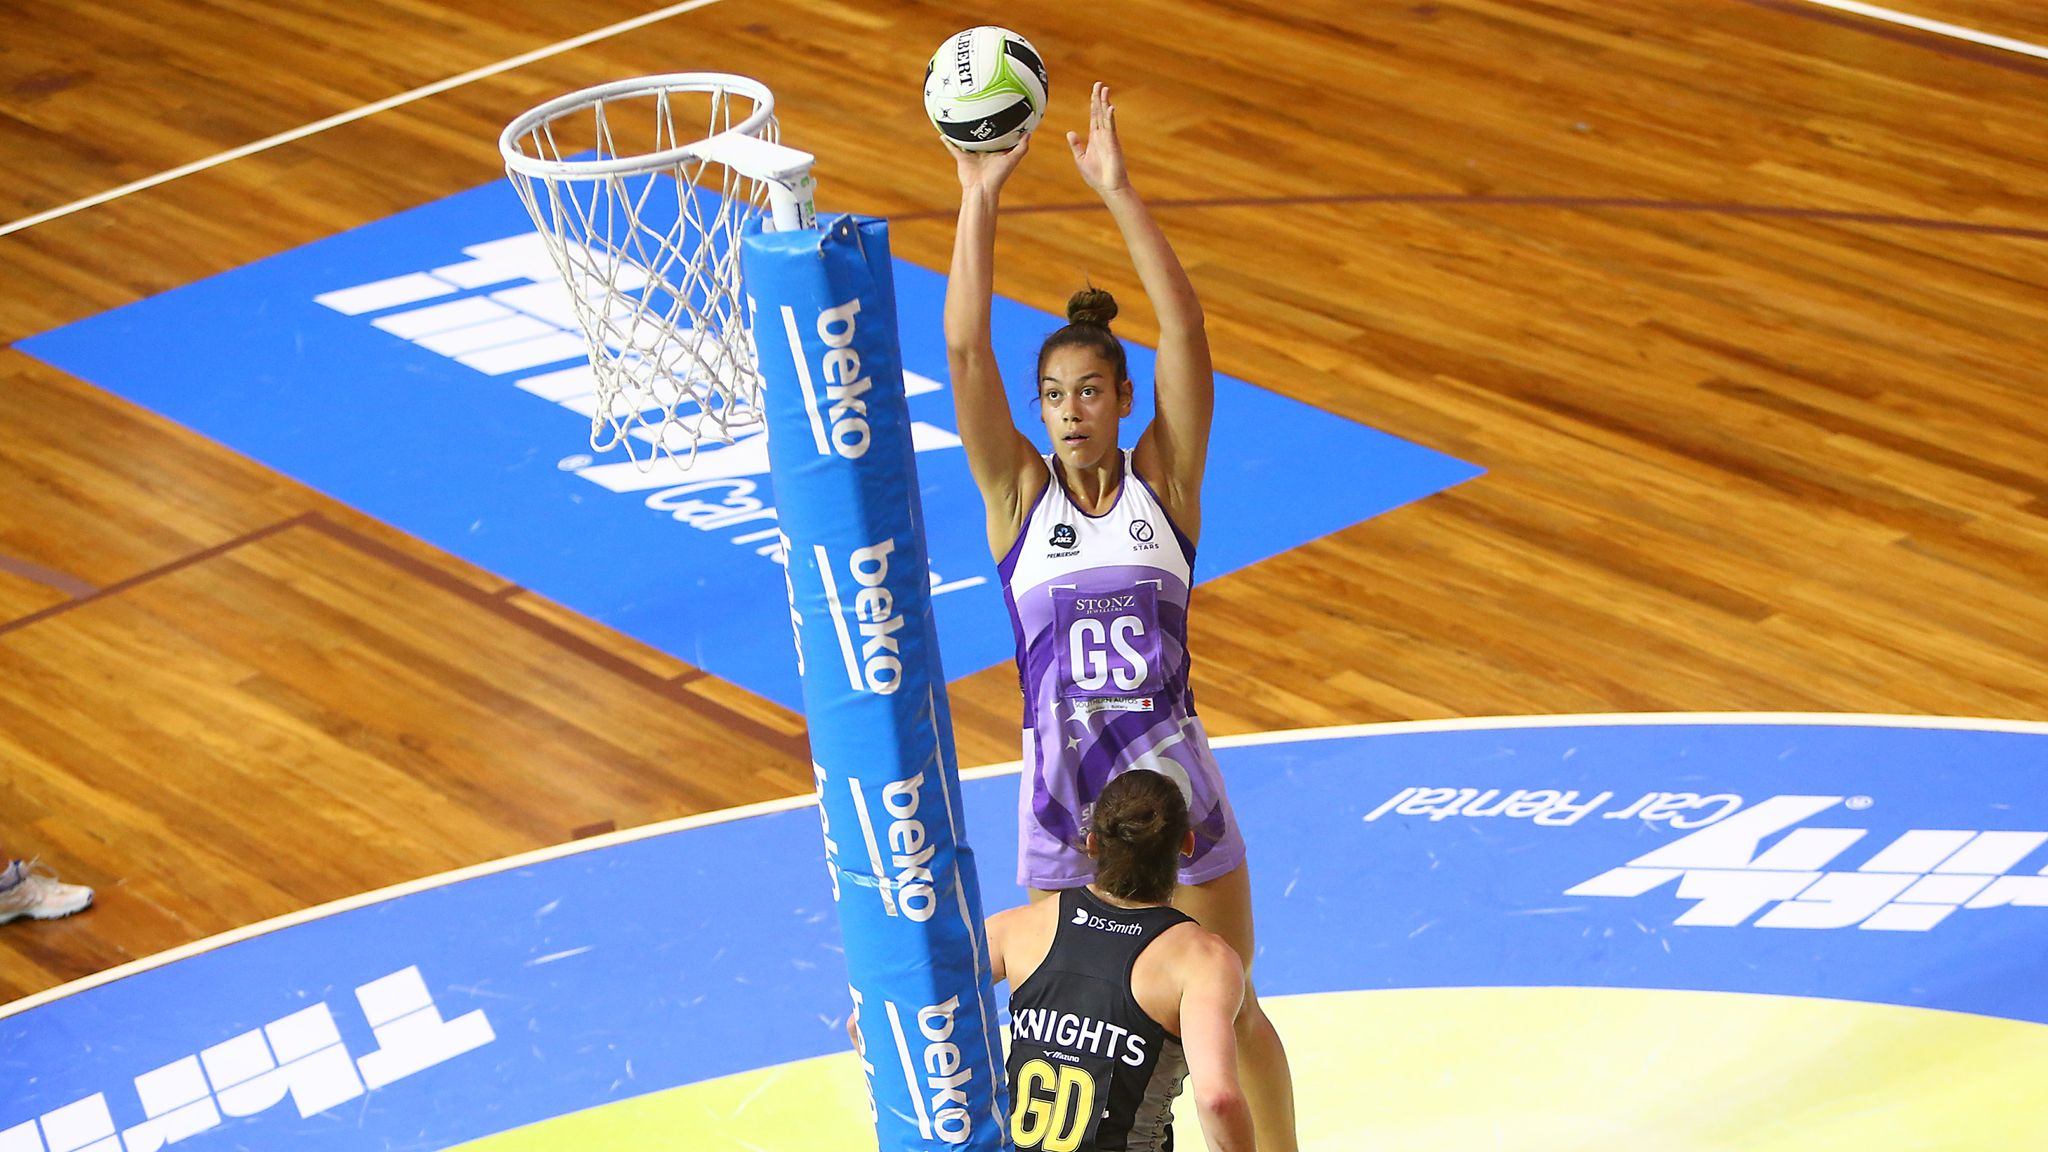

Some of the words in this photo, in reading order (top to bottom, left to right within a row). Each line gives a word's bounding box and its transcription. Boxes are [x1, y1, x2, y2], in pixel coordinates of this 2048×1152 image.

[816, 297, 872, 459] beko
[1132, 543, 1160, 551] STARS
[848, 537, 902, 696] beko
[1076, 595, 1135, 611] STONZ
[1068, 615, 1149, 691] GS
[1362, 786, 1615, 827] Rental
[1602, 791, 1743, 830] Car
[882, 771, 937, 923] beko
[1105, 920, 1143, 936] Smith
[917, 994, 974, 1144] beko
[1012, 1007, 1147, 1067] KNIGHTS
[1010, 1058, 1096, 1152] GD
